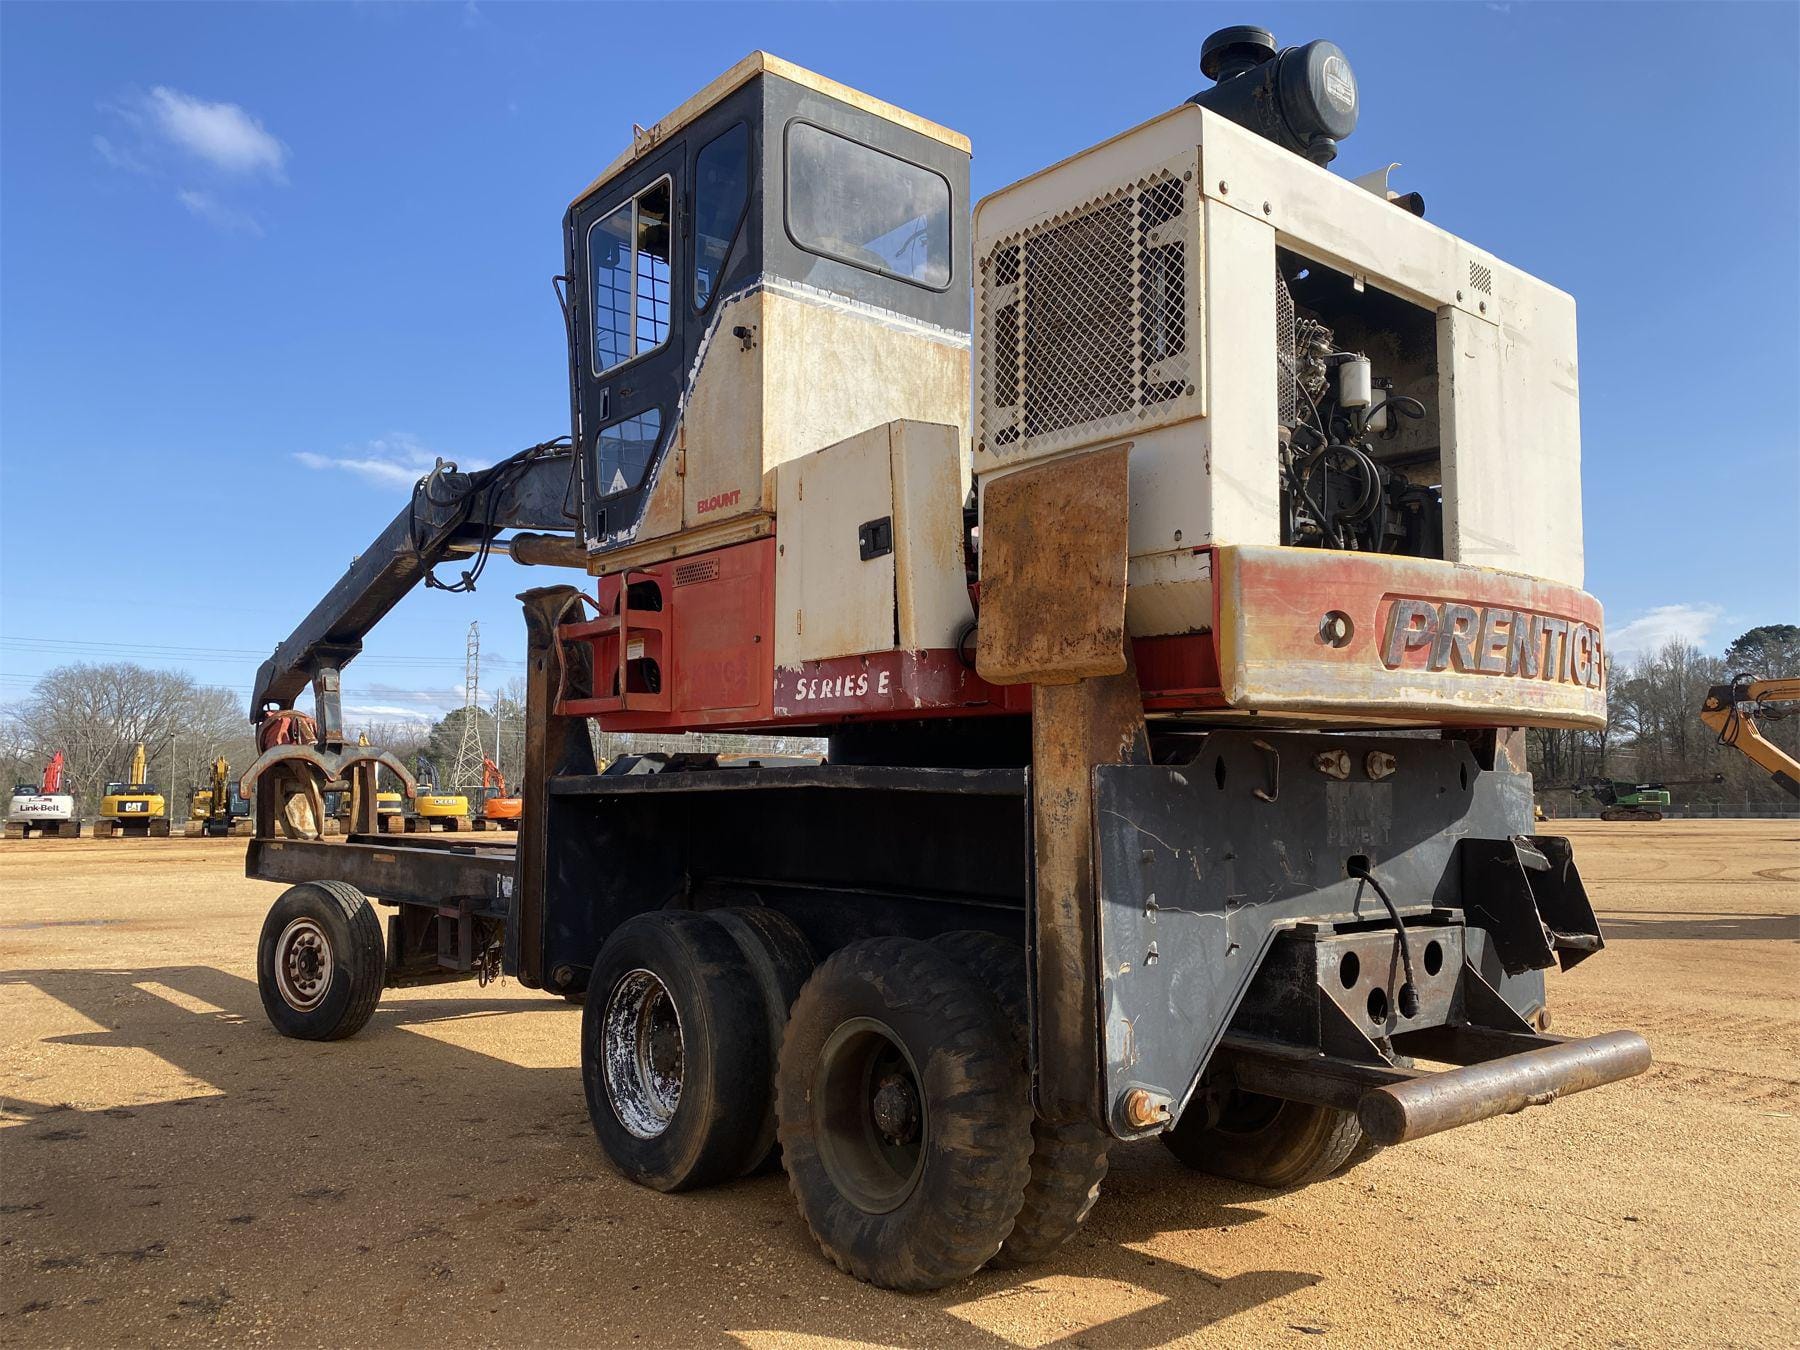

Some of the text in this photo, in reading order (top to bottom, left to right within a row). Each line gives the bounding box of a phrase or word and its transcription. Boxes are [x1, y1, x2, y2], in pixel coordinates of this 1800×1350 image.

[697, 490, 741, 513] BLOUNT
[1383, 600, 1600, 689] PRENTICE
[795, 671, 890, 700] SERIES E
[126, 802, 142, 812] CAT
